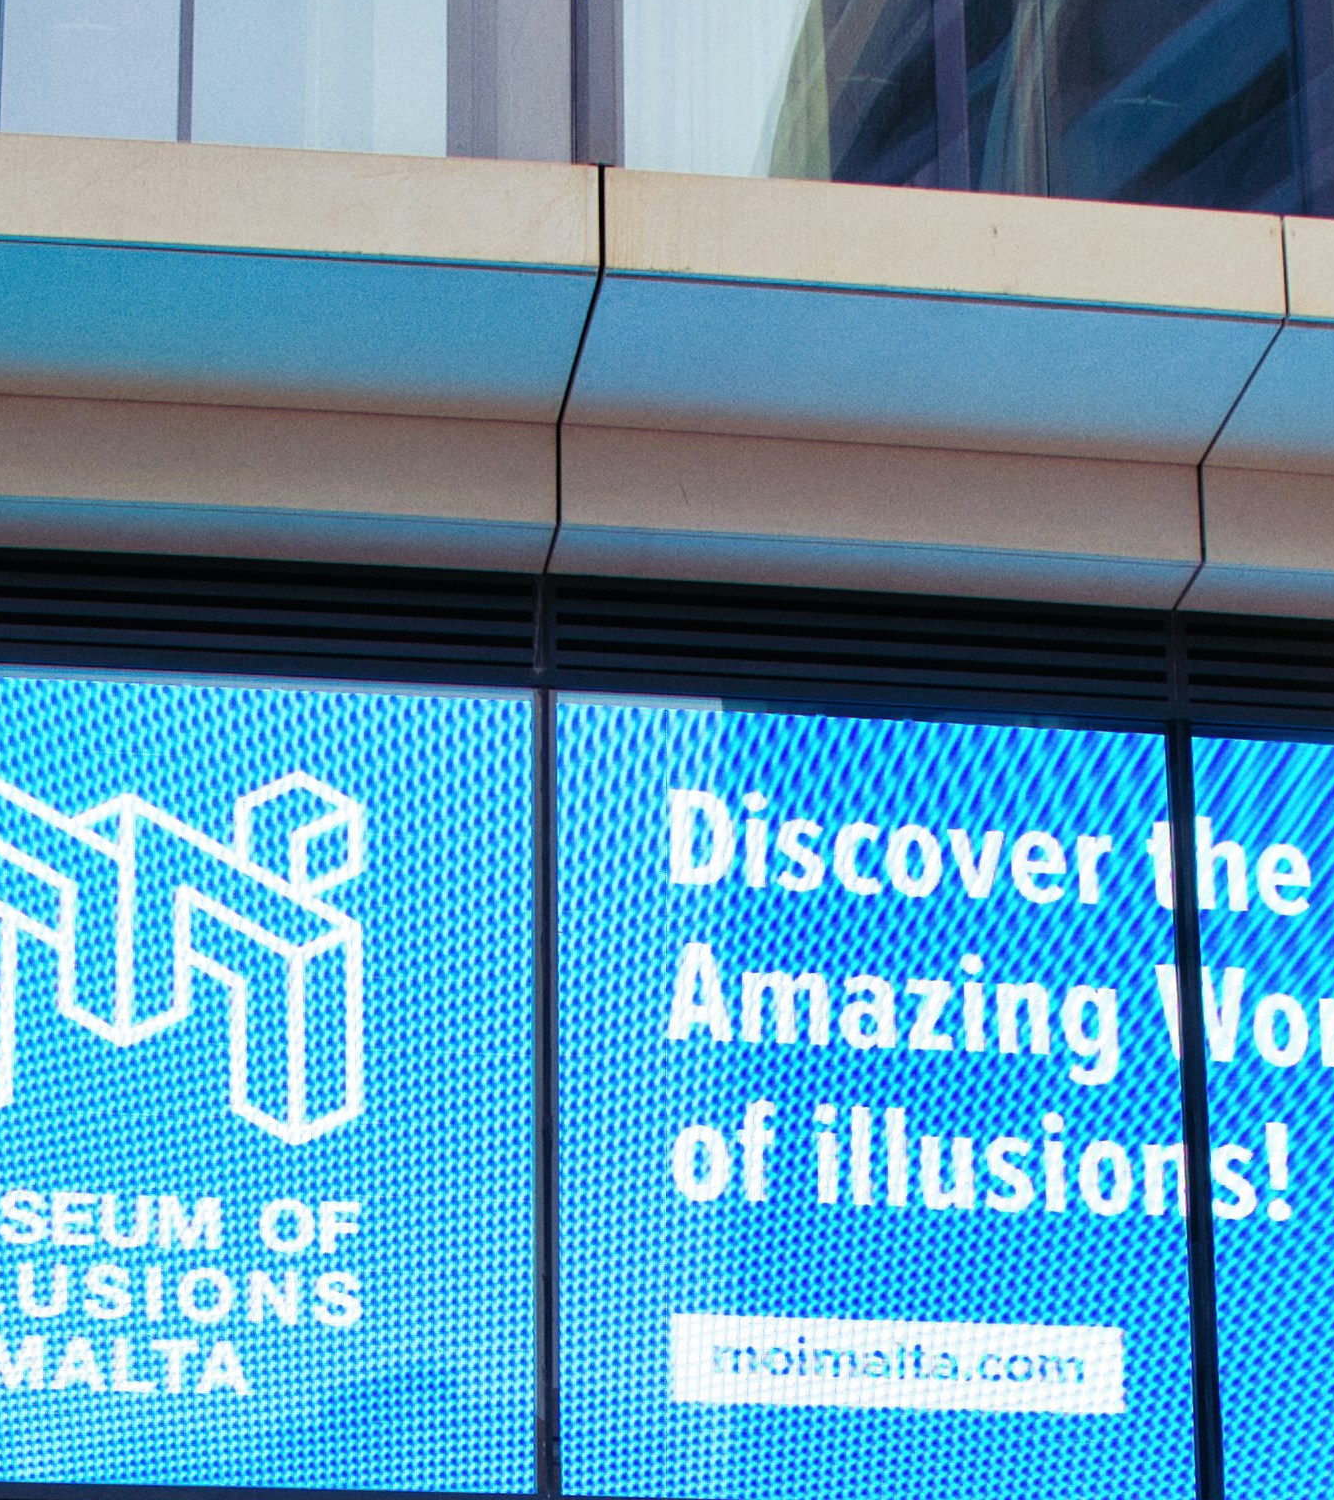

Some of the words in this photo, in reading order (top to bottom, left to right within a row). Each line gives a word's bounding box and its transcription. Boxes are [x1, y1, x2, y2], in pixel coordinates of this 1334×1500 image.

[669, 787, 1112, 907] Discover
[1146, 815, 1312, 917] the
[671, 941, 1120, 1086] Amazing
[675, 1100, 776, 1203] of
[815, 1104, 1294, 1223] illusions!
[259, 1197, 362, 1254] OF
[711, 1335, 1085, 1385] moimalta.com
